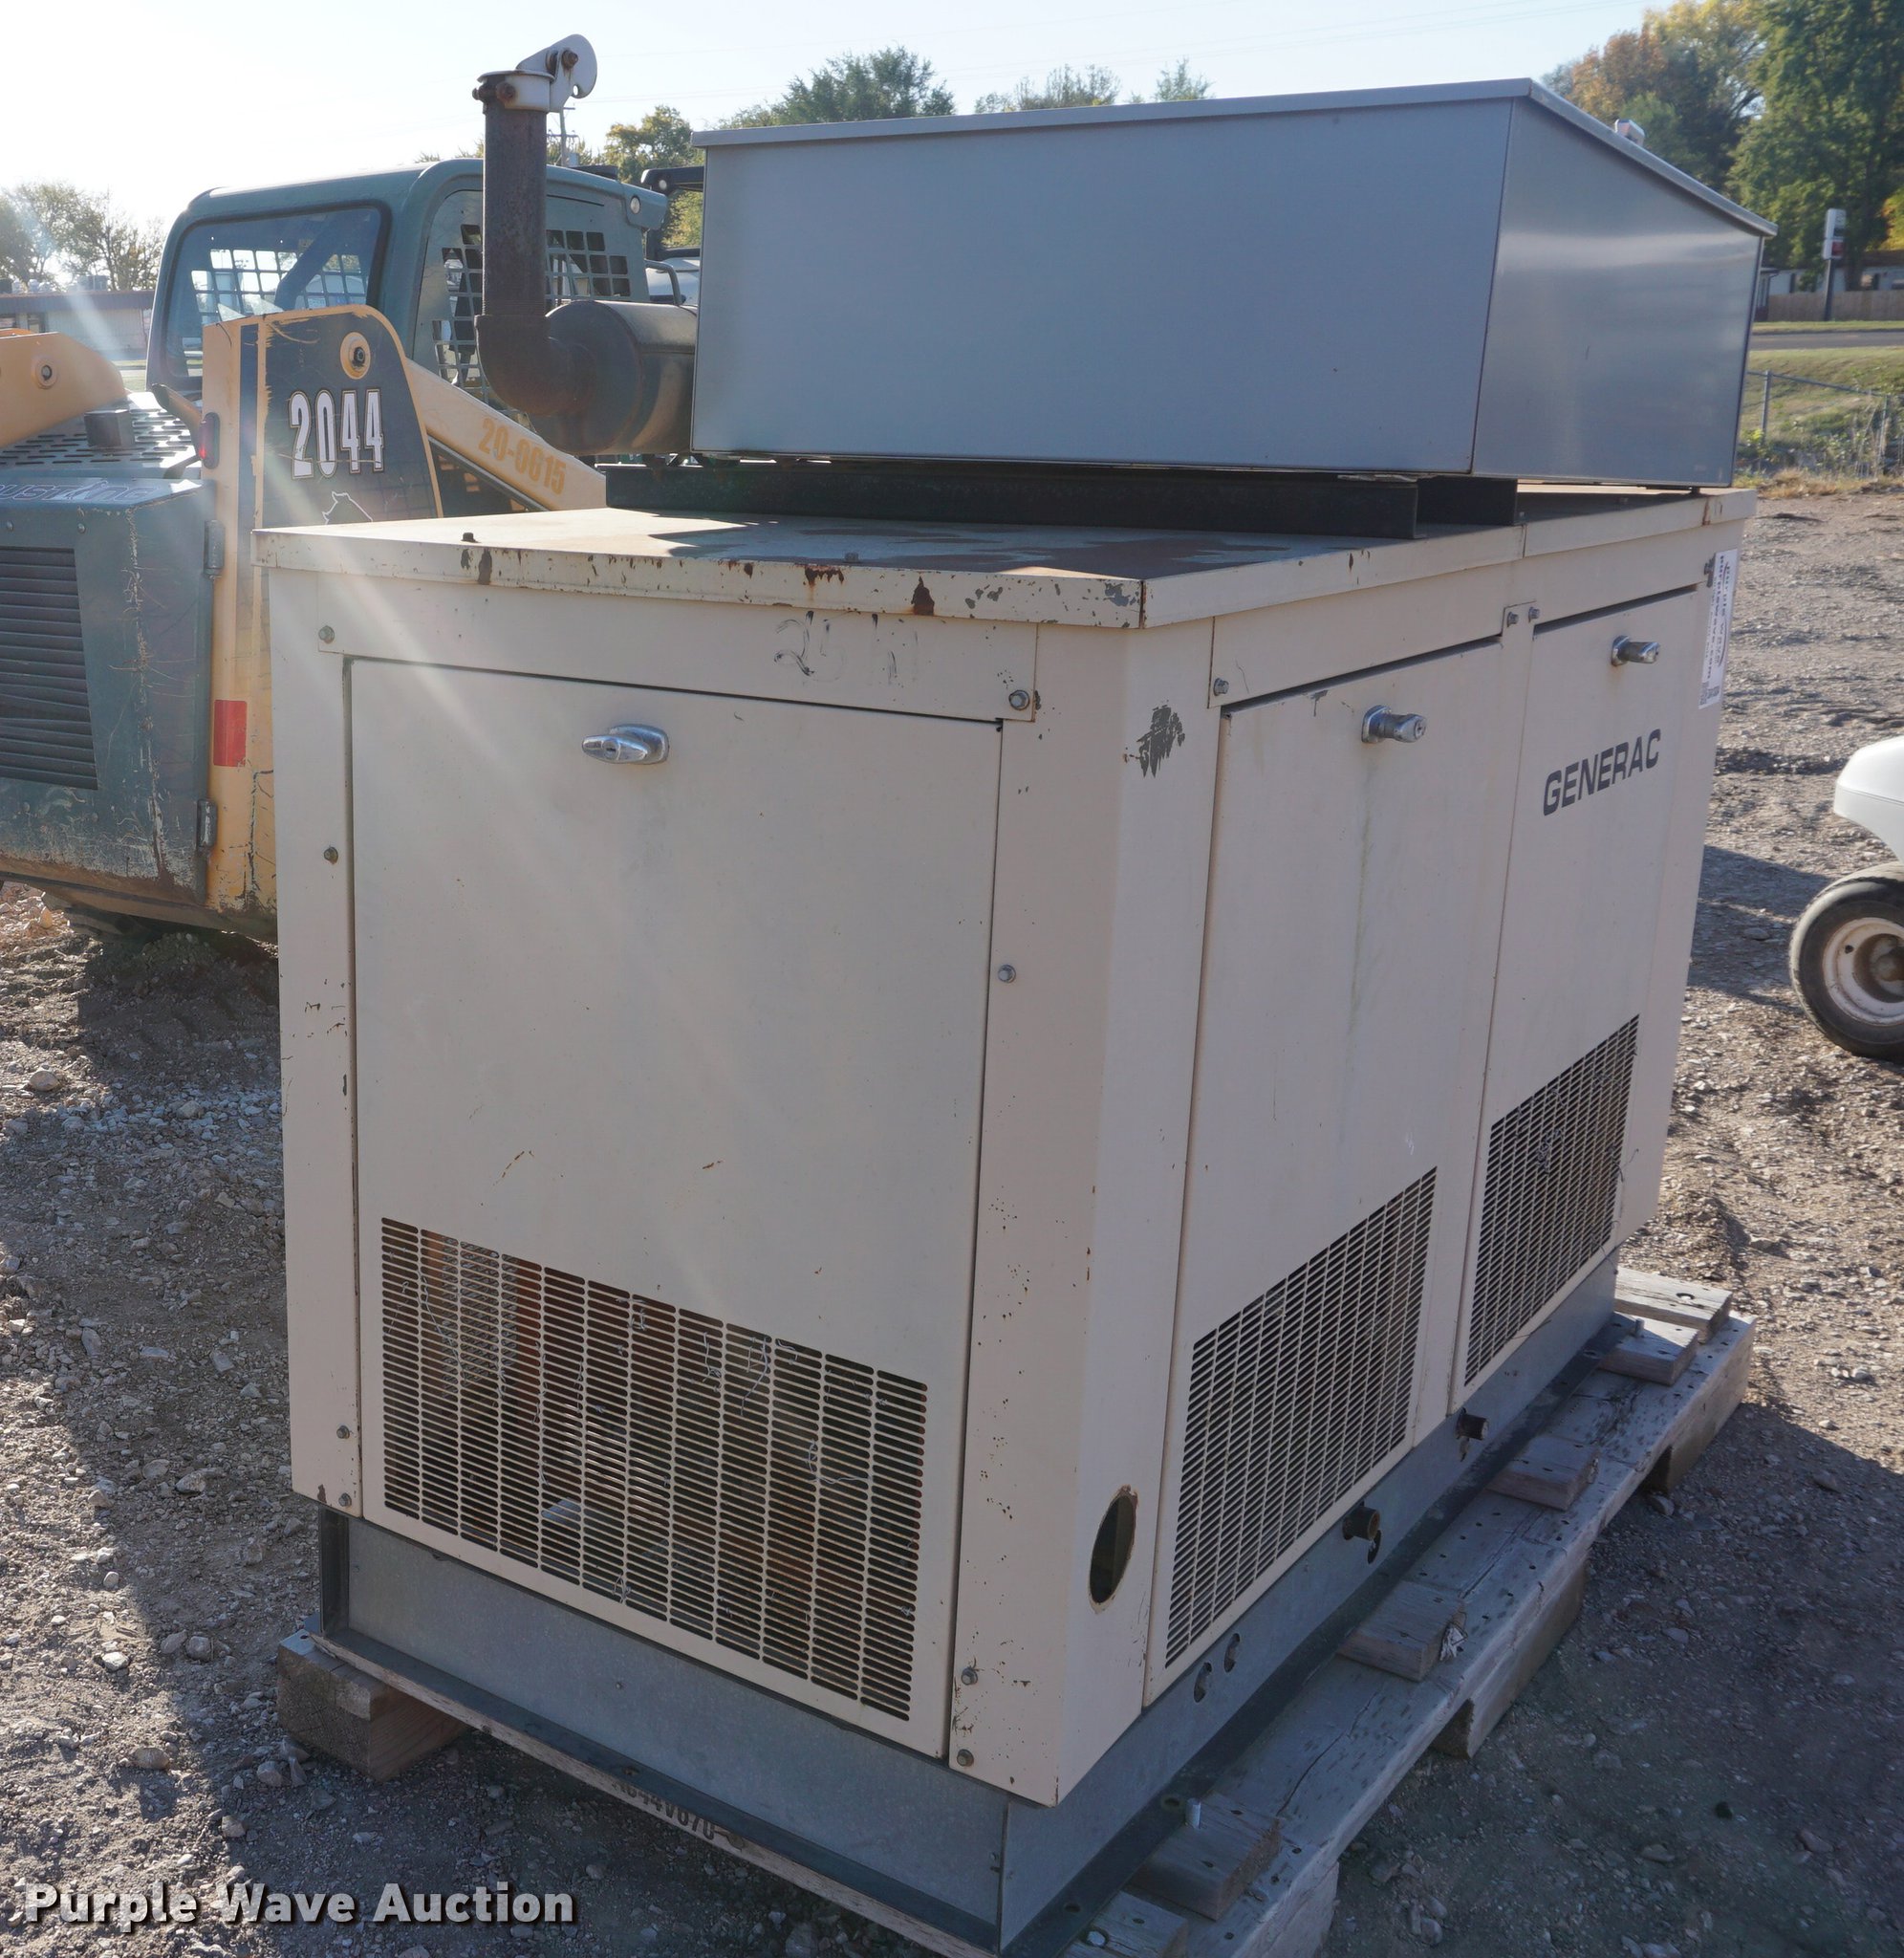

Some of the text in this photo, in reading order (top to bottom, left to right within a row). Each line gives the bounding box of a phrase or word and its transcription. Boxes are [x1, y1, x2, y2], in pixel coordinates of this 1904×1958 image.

[289, 388, 384, 479] 2044
[479, 417, 567, 495] 20-0615
[1543, 729, 1661, 816] GENERAC
